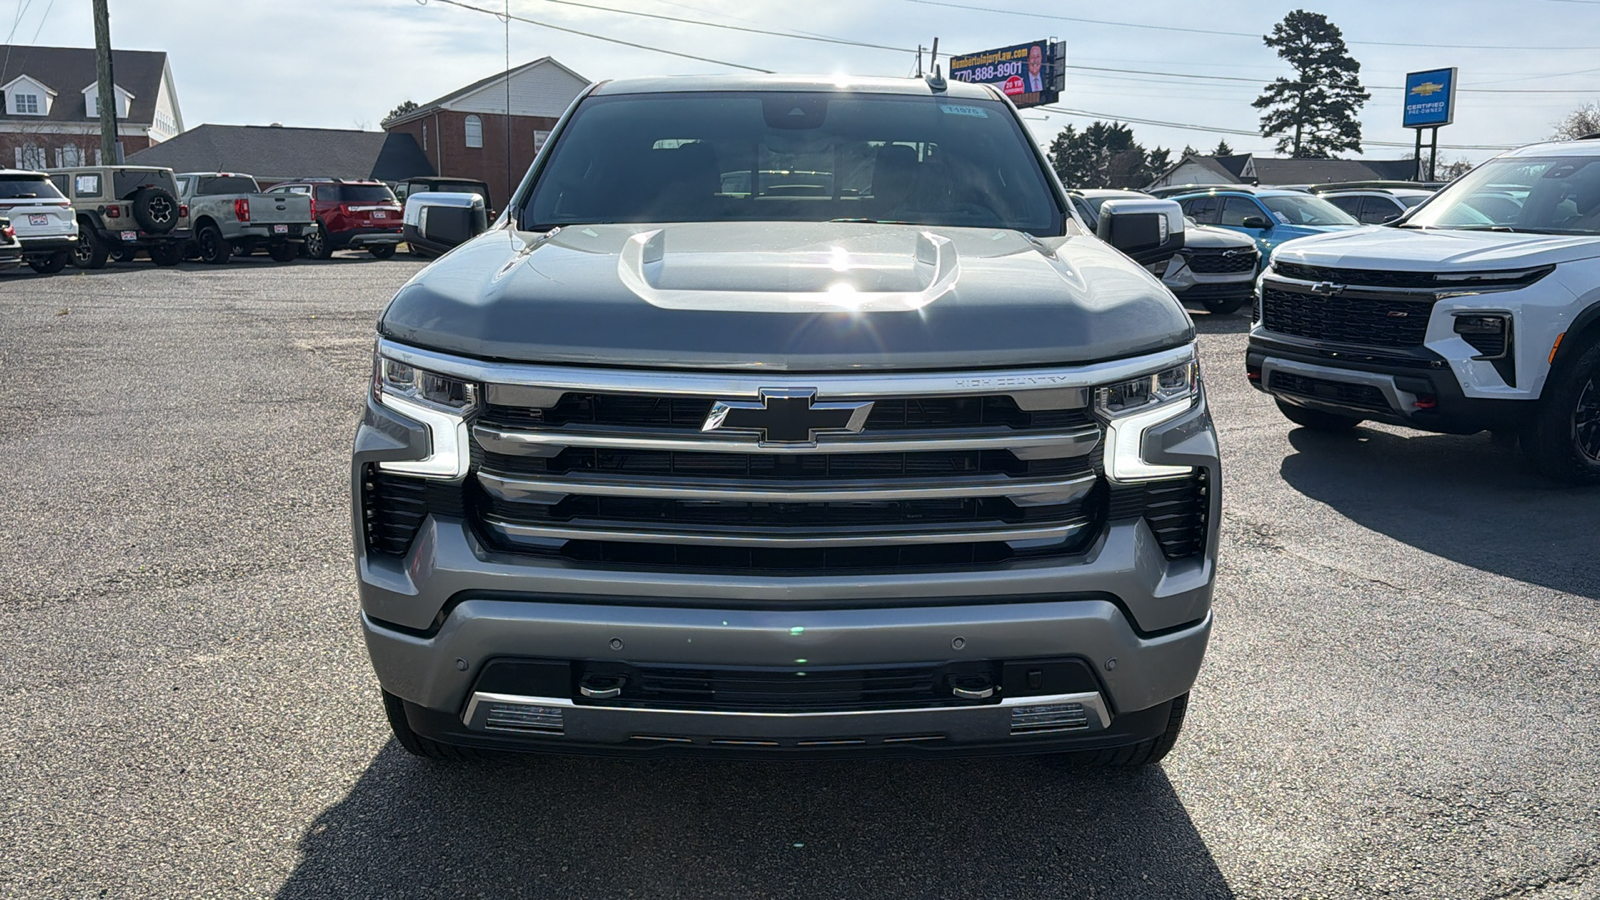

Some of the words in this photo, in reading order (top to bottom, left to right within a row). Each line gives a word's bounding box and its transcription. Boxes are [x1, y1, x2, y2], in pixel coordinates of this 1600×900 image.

[954, 61, 1022, 82] 770-888-8901
[1407, 101, 1445, 110] CERTIFIED
[955, 379, 992, 388] HIGH
[997, 375, 1067, 386] COUNTRY
